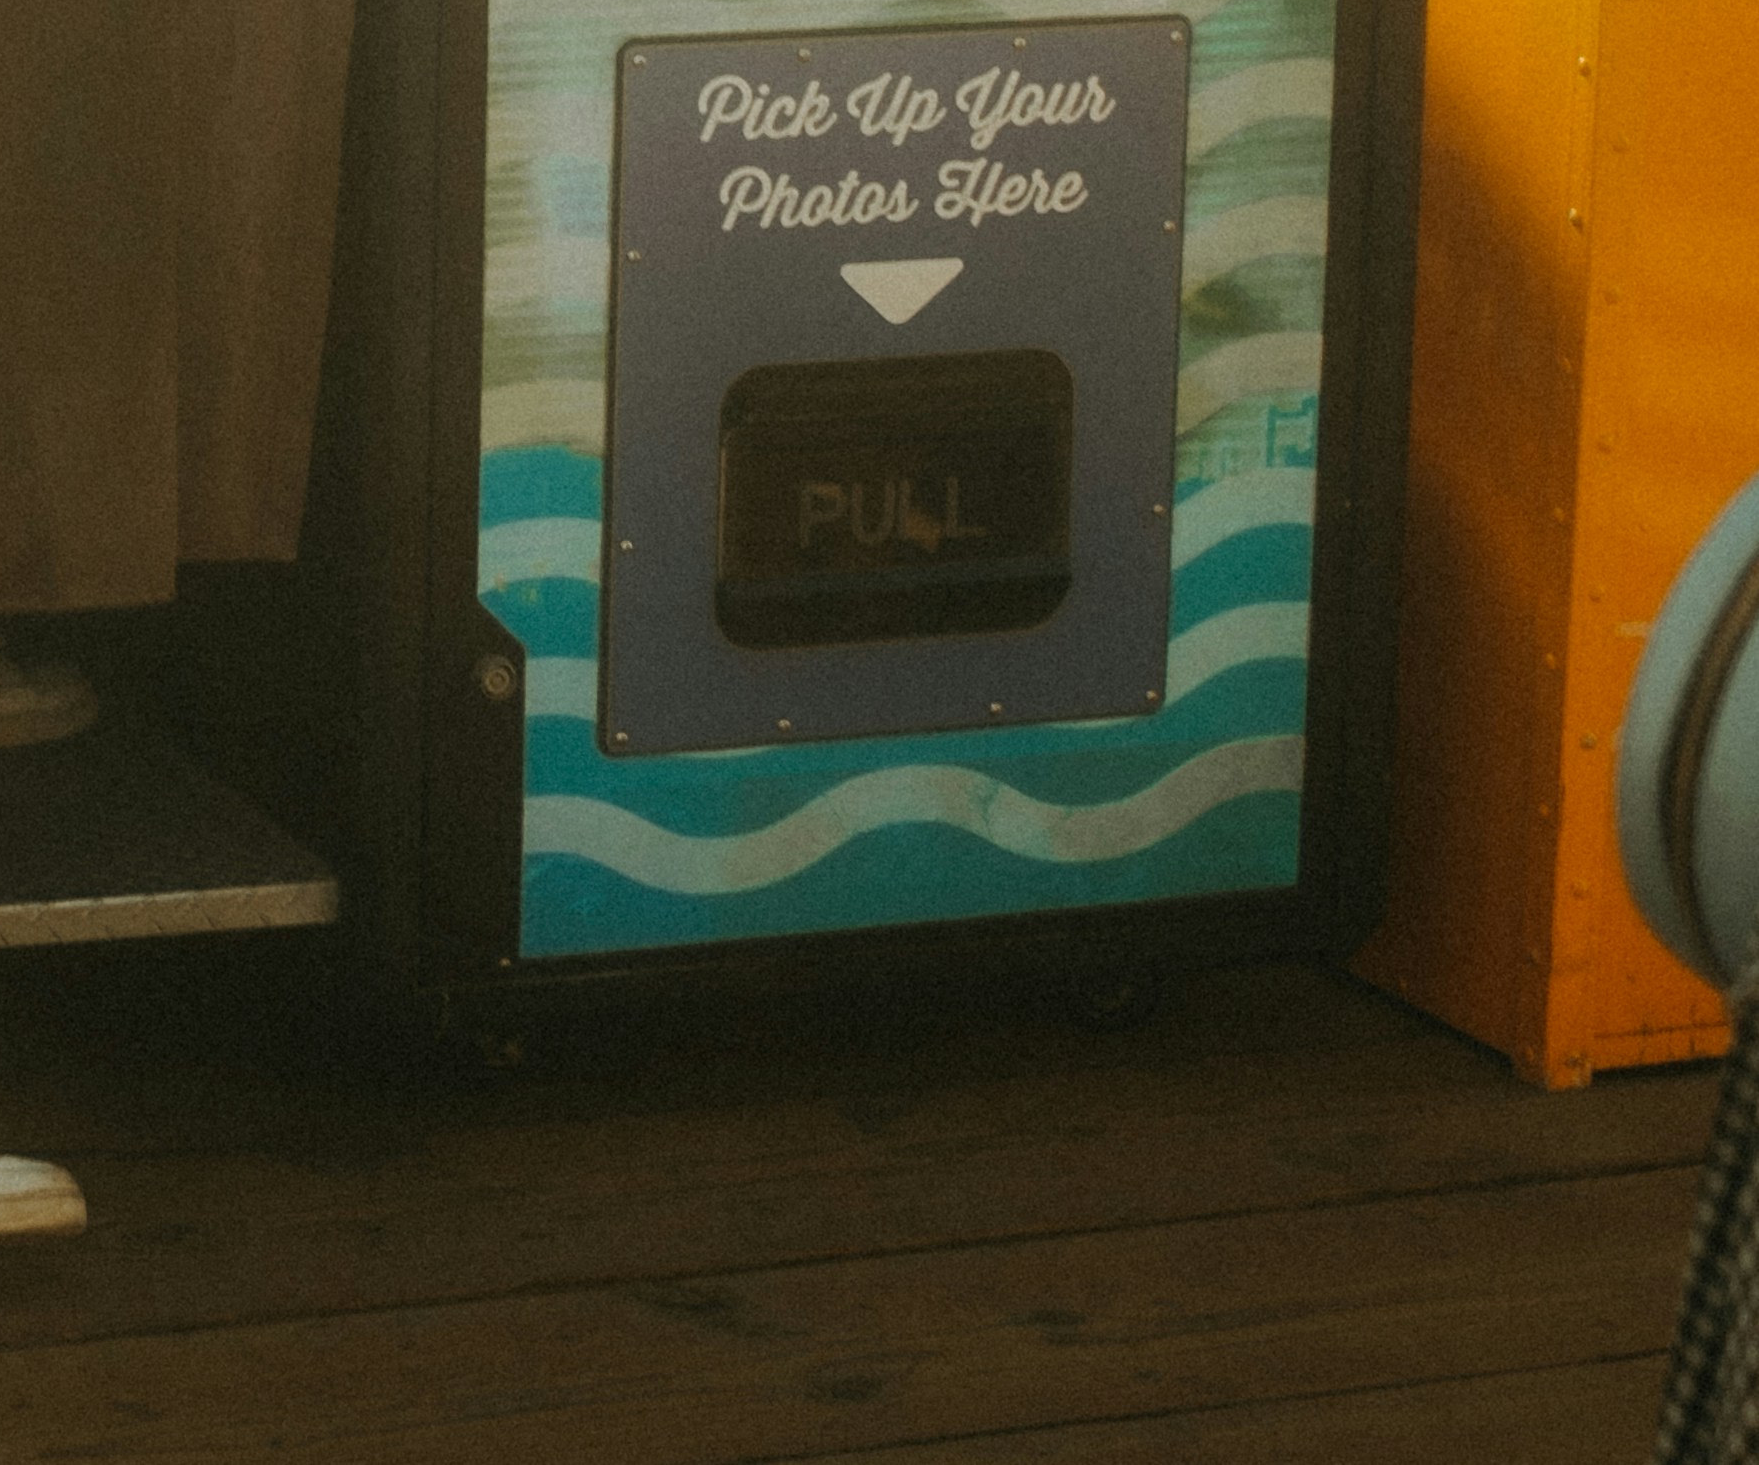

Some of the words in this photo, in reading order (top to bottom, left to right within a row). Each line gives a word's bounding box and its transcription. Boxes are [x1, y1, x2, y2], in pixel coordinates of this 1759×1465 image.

[698, 74, 837, 143] Pick
[847, 72, 946, 146] Up
[955, 67, 1115, 151] Your
[719, 166, 919, 232] Photos
[934, 157, 1089, 228] Here
[796, 474, 988, 551] PULL
